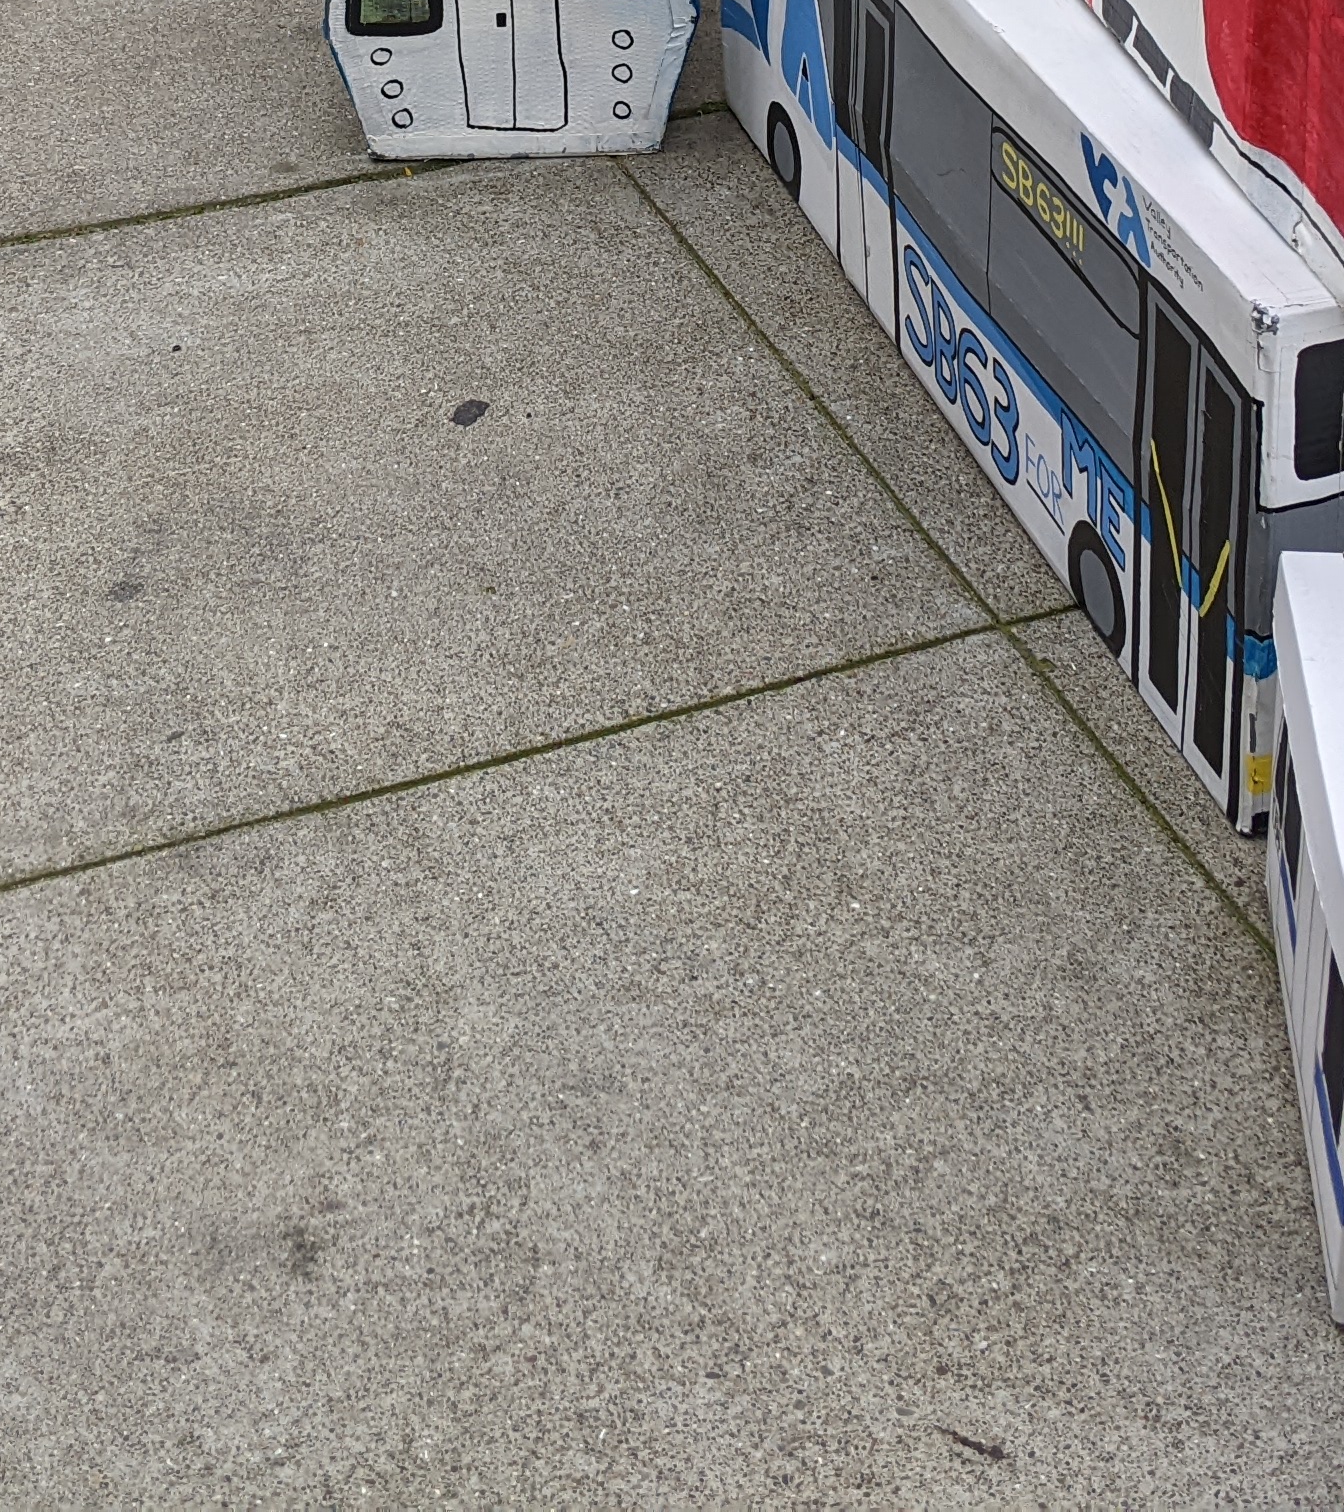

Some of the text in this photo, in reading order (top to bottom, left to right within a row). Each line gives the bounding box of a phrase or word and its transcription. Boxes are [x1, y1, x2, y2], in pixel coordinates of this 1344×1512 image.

[1001, 141, 1085, 266] SB63!!!
[1142, 194, 1172, 240] Valley
[1145, 216, 1204, 293] Transportation
[1150, 242, 1184, 289] Authority
[904, 244, 1127, 574] SB63 FOR ME
